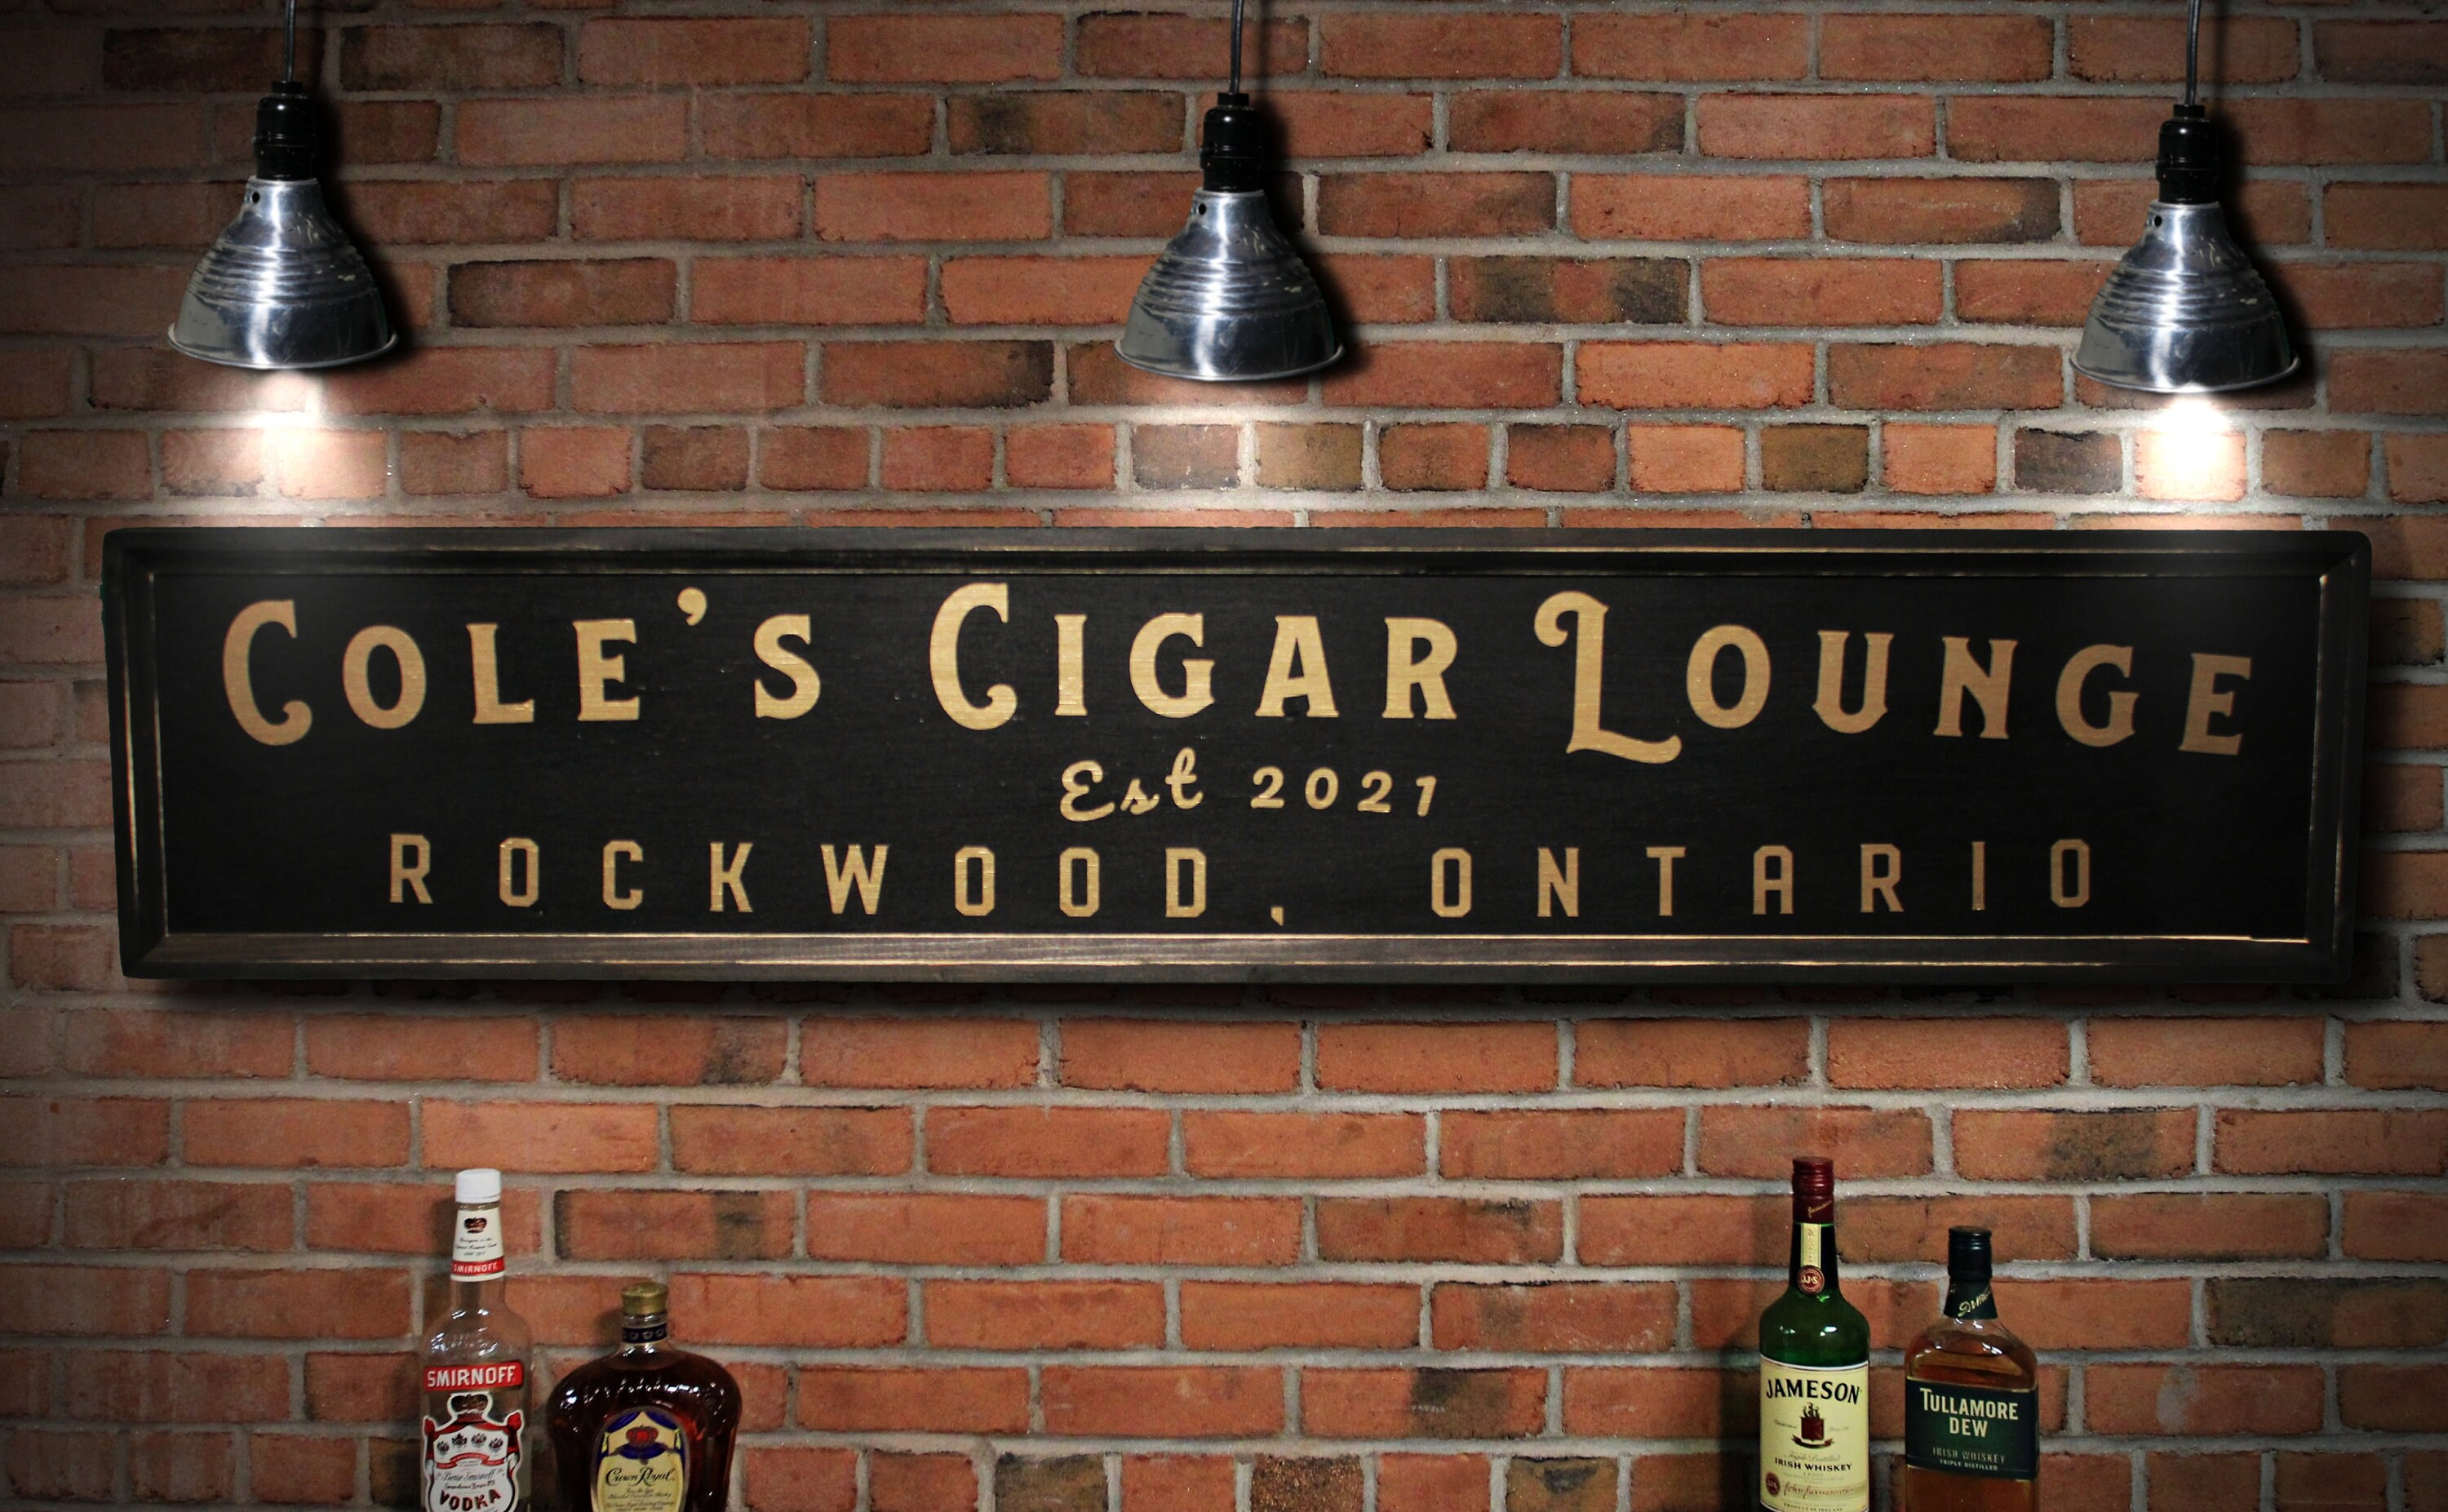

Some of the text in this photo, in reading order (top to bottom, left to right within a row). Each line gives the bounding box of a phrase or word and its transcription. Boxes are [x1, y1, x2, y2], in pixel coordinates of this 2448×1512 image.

[929, 582, 1457, 730] CIGAR
[1534, 591, 2252, 764] LOUNGE
[1059, 747, 1438, 822] Est 2021
[390, 834, 2091, 927] ROCKWOOD, ONTARIO
[453, 1261, 498, 1274] SMIRNOFF
[427, 1365, 517, 1387] SMIRNOFF
[1766, 1377, 1860, 1404] JAMESON
[1919, 1387, 2019, 1421] TULLAMORE
[1949, 1417, 1989, 1438] DEW
[1775, 1457, 1852, 1472] IRISH WHISKEY
[1932, 1447, 2006, 1465] IRISH WHISKEY
[1940, 1459, 1998, 1471] TRIPLE DISTILLED
[605, 1467, 675, 1487] Crown Royal
[440, 1488, 501, 1511] VODKA
